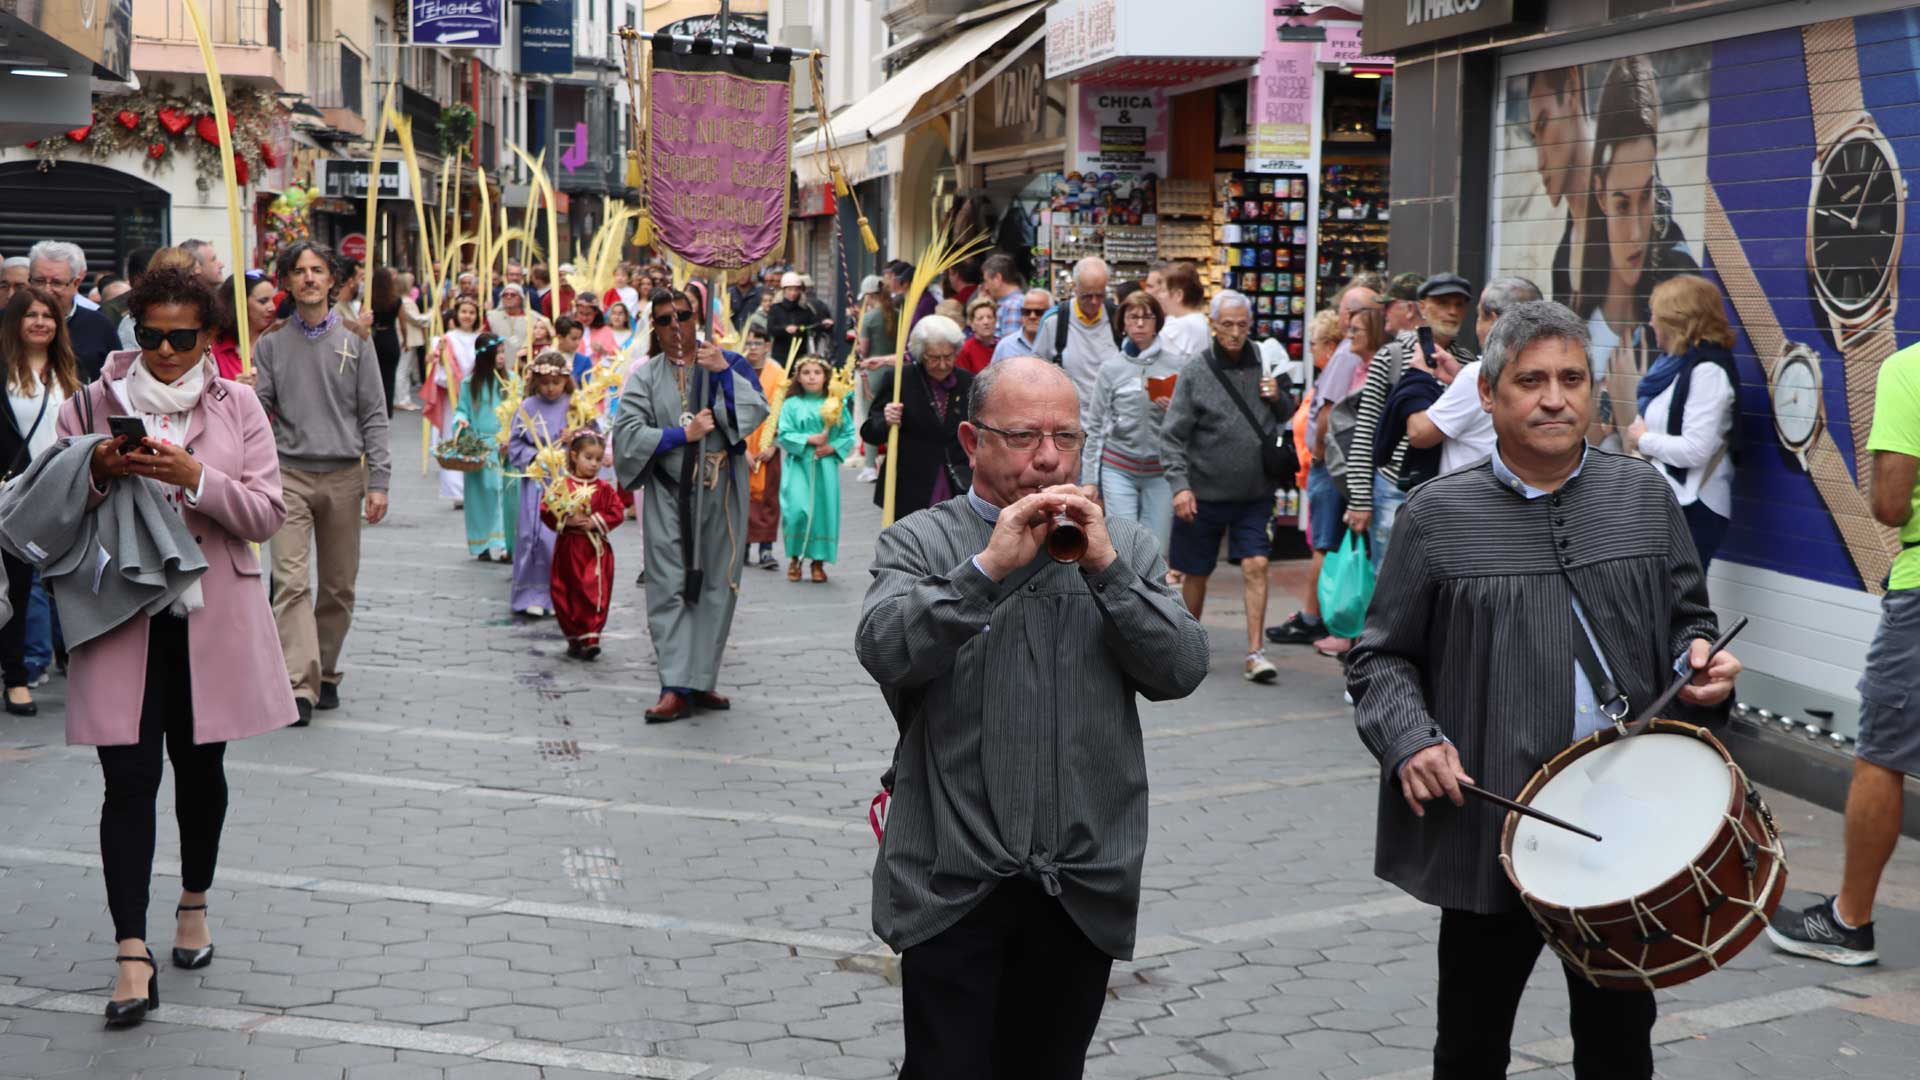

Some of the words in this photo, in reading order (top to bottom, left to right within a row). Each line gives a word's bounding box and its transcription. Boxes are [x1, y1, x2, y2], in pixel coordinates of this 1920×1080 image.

[1276, 59, 1298, 74] WE
[1098, 95, 1153, 109] CHICA
[1118, 110, 1132, 124] &
